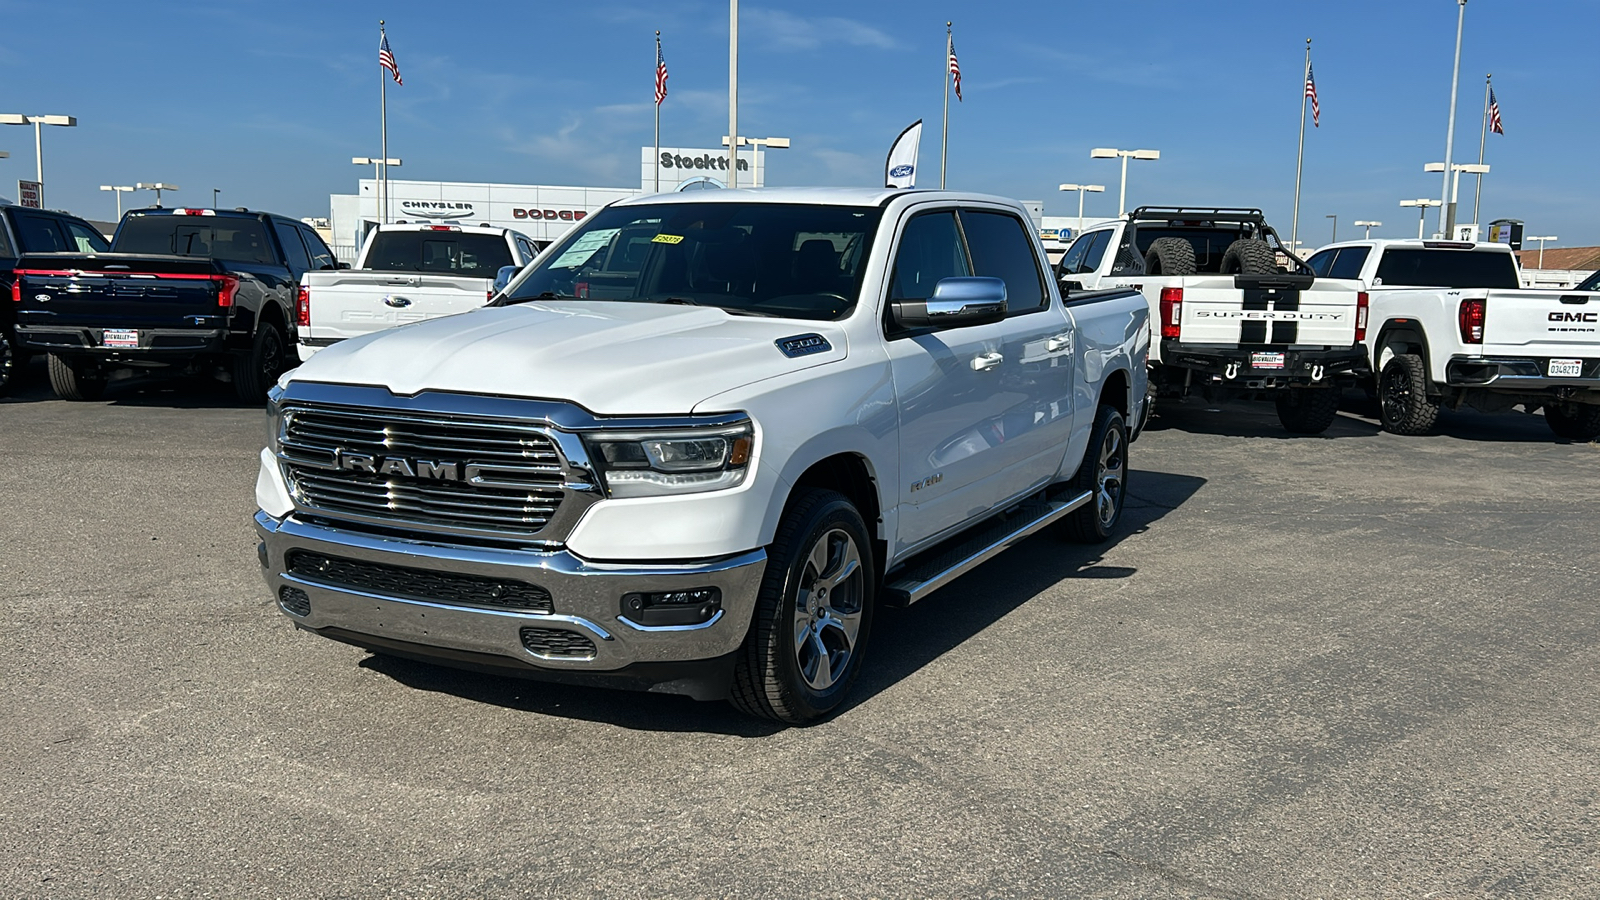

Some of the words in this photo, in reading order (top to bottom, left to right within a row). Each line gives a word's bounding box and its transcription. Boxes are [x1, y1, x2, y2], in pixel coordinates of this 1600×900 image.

[22, 191, 36, 199] USED
[21, 199, 39, 208] CARS
[402, 201, 473, 210] CHRYSLER
[1197, 311, 1276, 319] SUPER
[1283, 312, 1342, 320] DUTY
[1548, 312, 1598, 323] GMC
[341, 450, 458, 481] RAM
[911, 472, 943, 492] RAM
